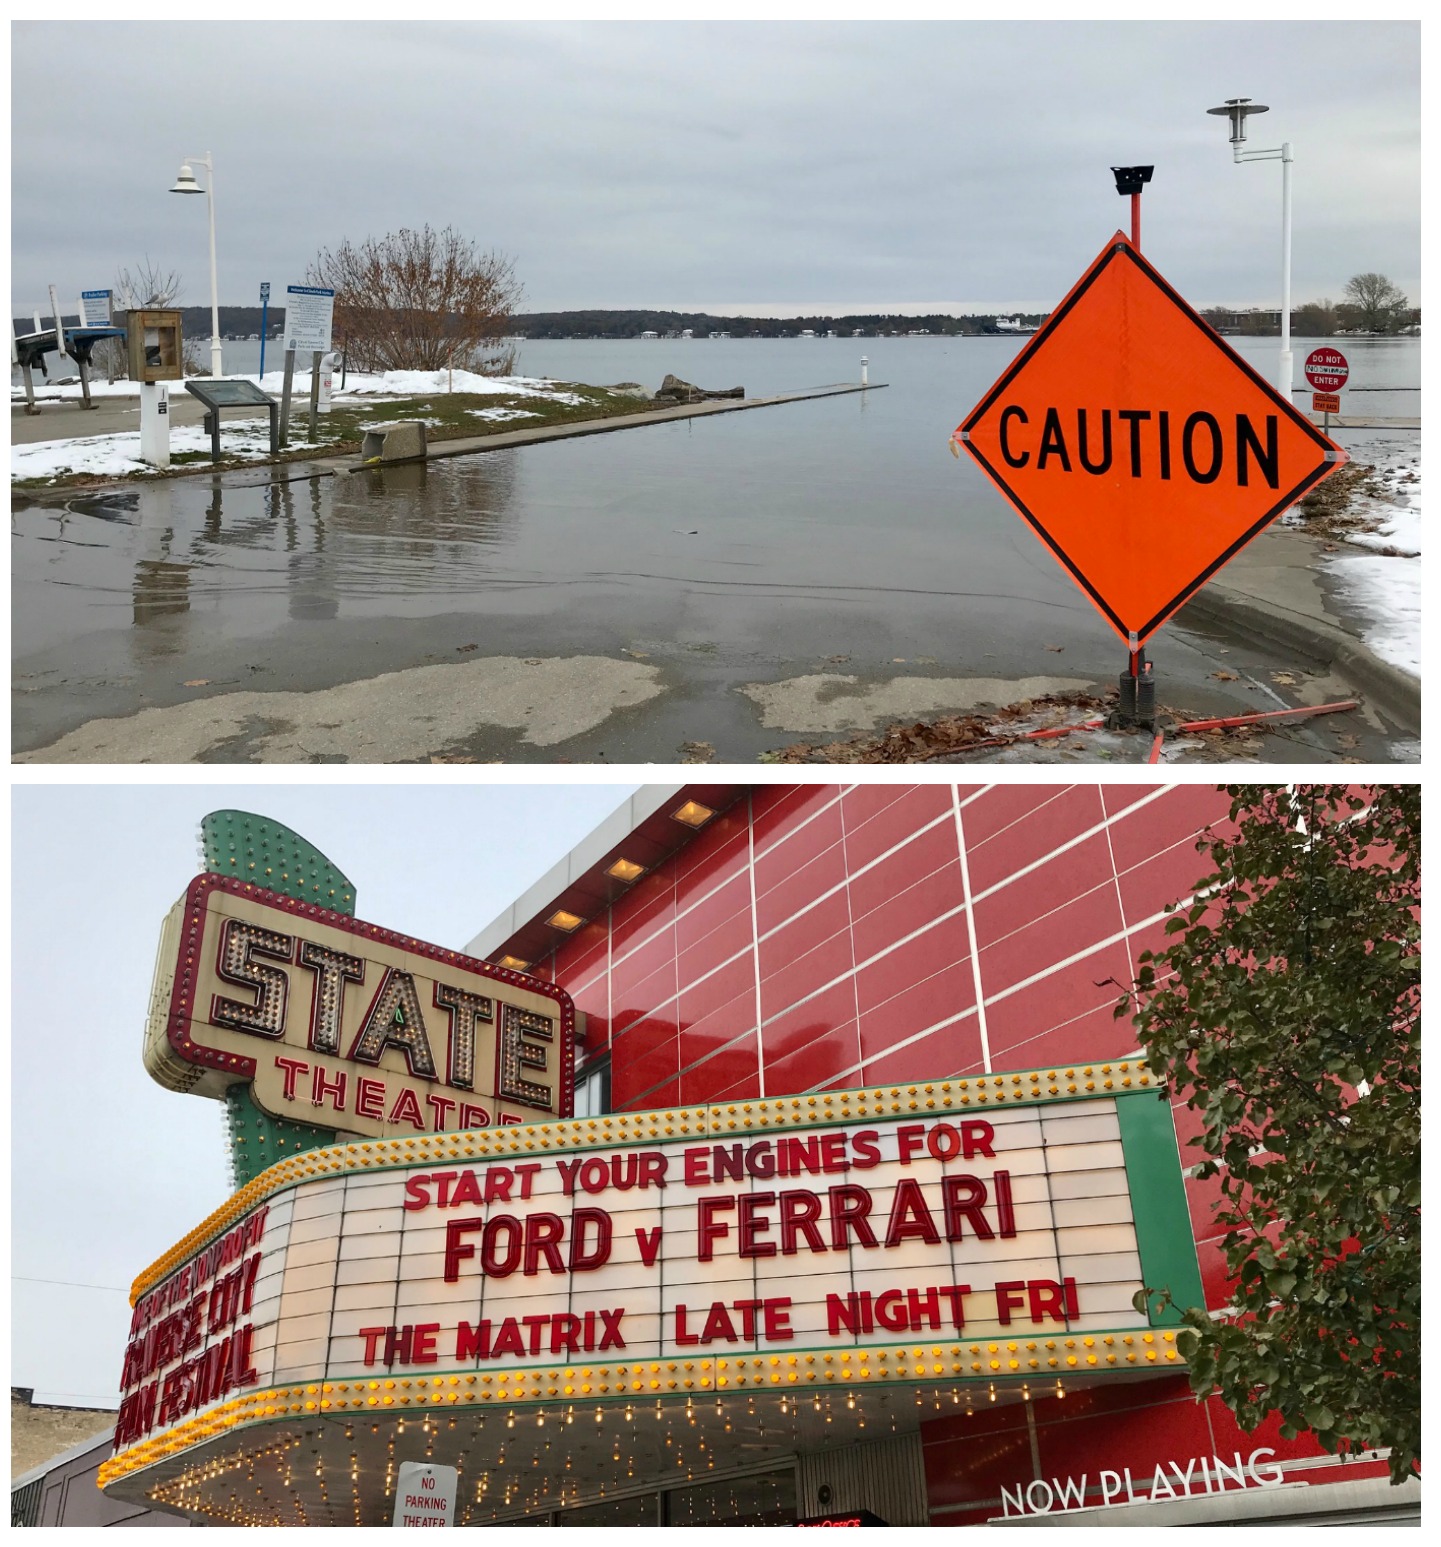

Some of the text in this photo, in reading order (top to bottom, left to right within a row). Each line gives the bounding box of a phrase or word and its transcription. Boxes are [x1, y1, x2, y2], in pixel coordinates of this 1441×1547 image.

[1312, 355, 1341, 364] DO NOT
[1314, 376, 1338, 385] ENTER
[999, 404, 1280, 490] CAUTION
[210, 917, 554, 1107] STATE
[403, 1118, 996, 1211] START YOUR ENGINES FOR
[168, 1265, 191, 1305] THE
[191, 1205, 270, 1292] NONPROFIT
[443, 1206, 613, 1283] FORD
[697, 1169, 1017, 1262] FERRARI
[208, 1251, 262, 1335] CITY
[359, 1277, 1081, 1366] THE MATRIX LATE NIGHT FRI
[157, 1323, 257, 1427] FESTIVAL
[405, 1495, 447, 1511] PARKING
[421, 1477, 436, 1490] NO
[1000, 1447, 1285, 1518] NOW PLAYING
